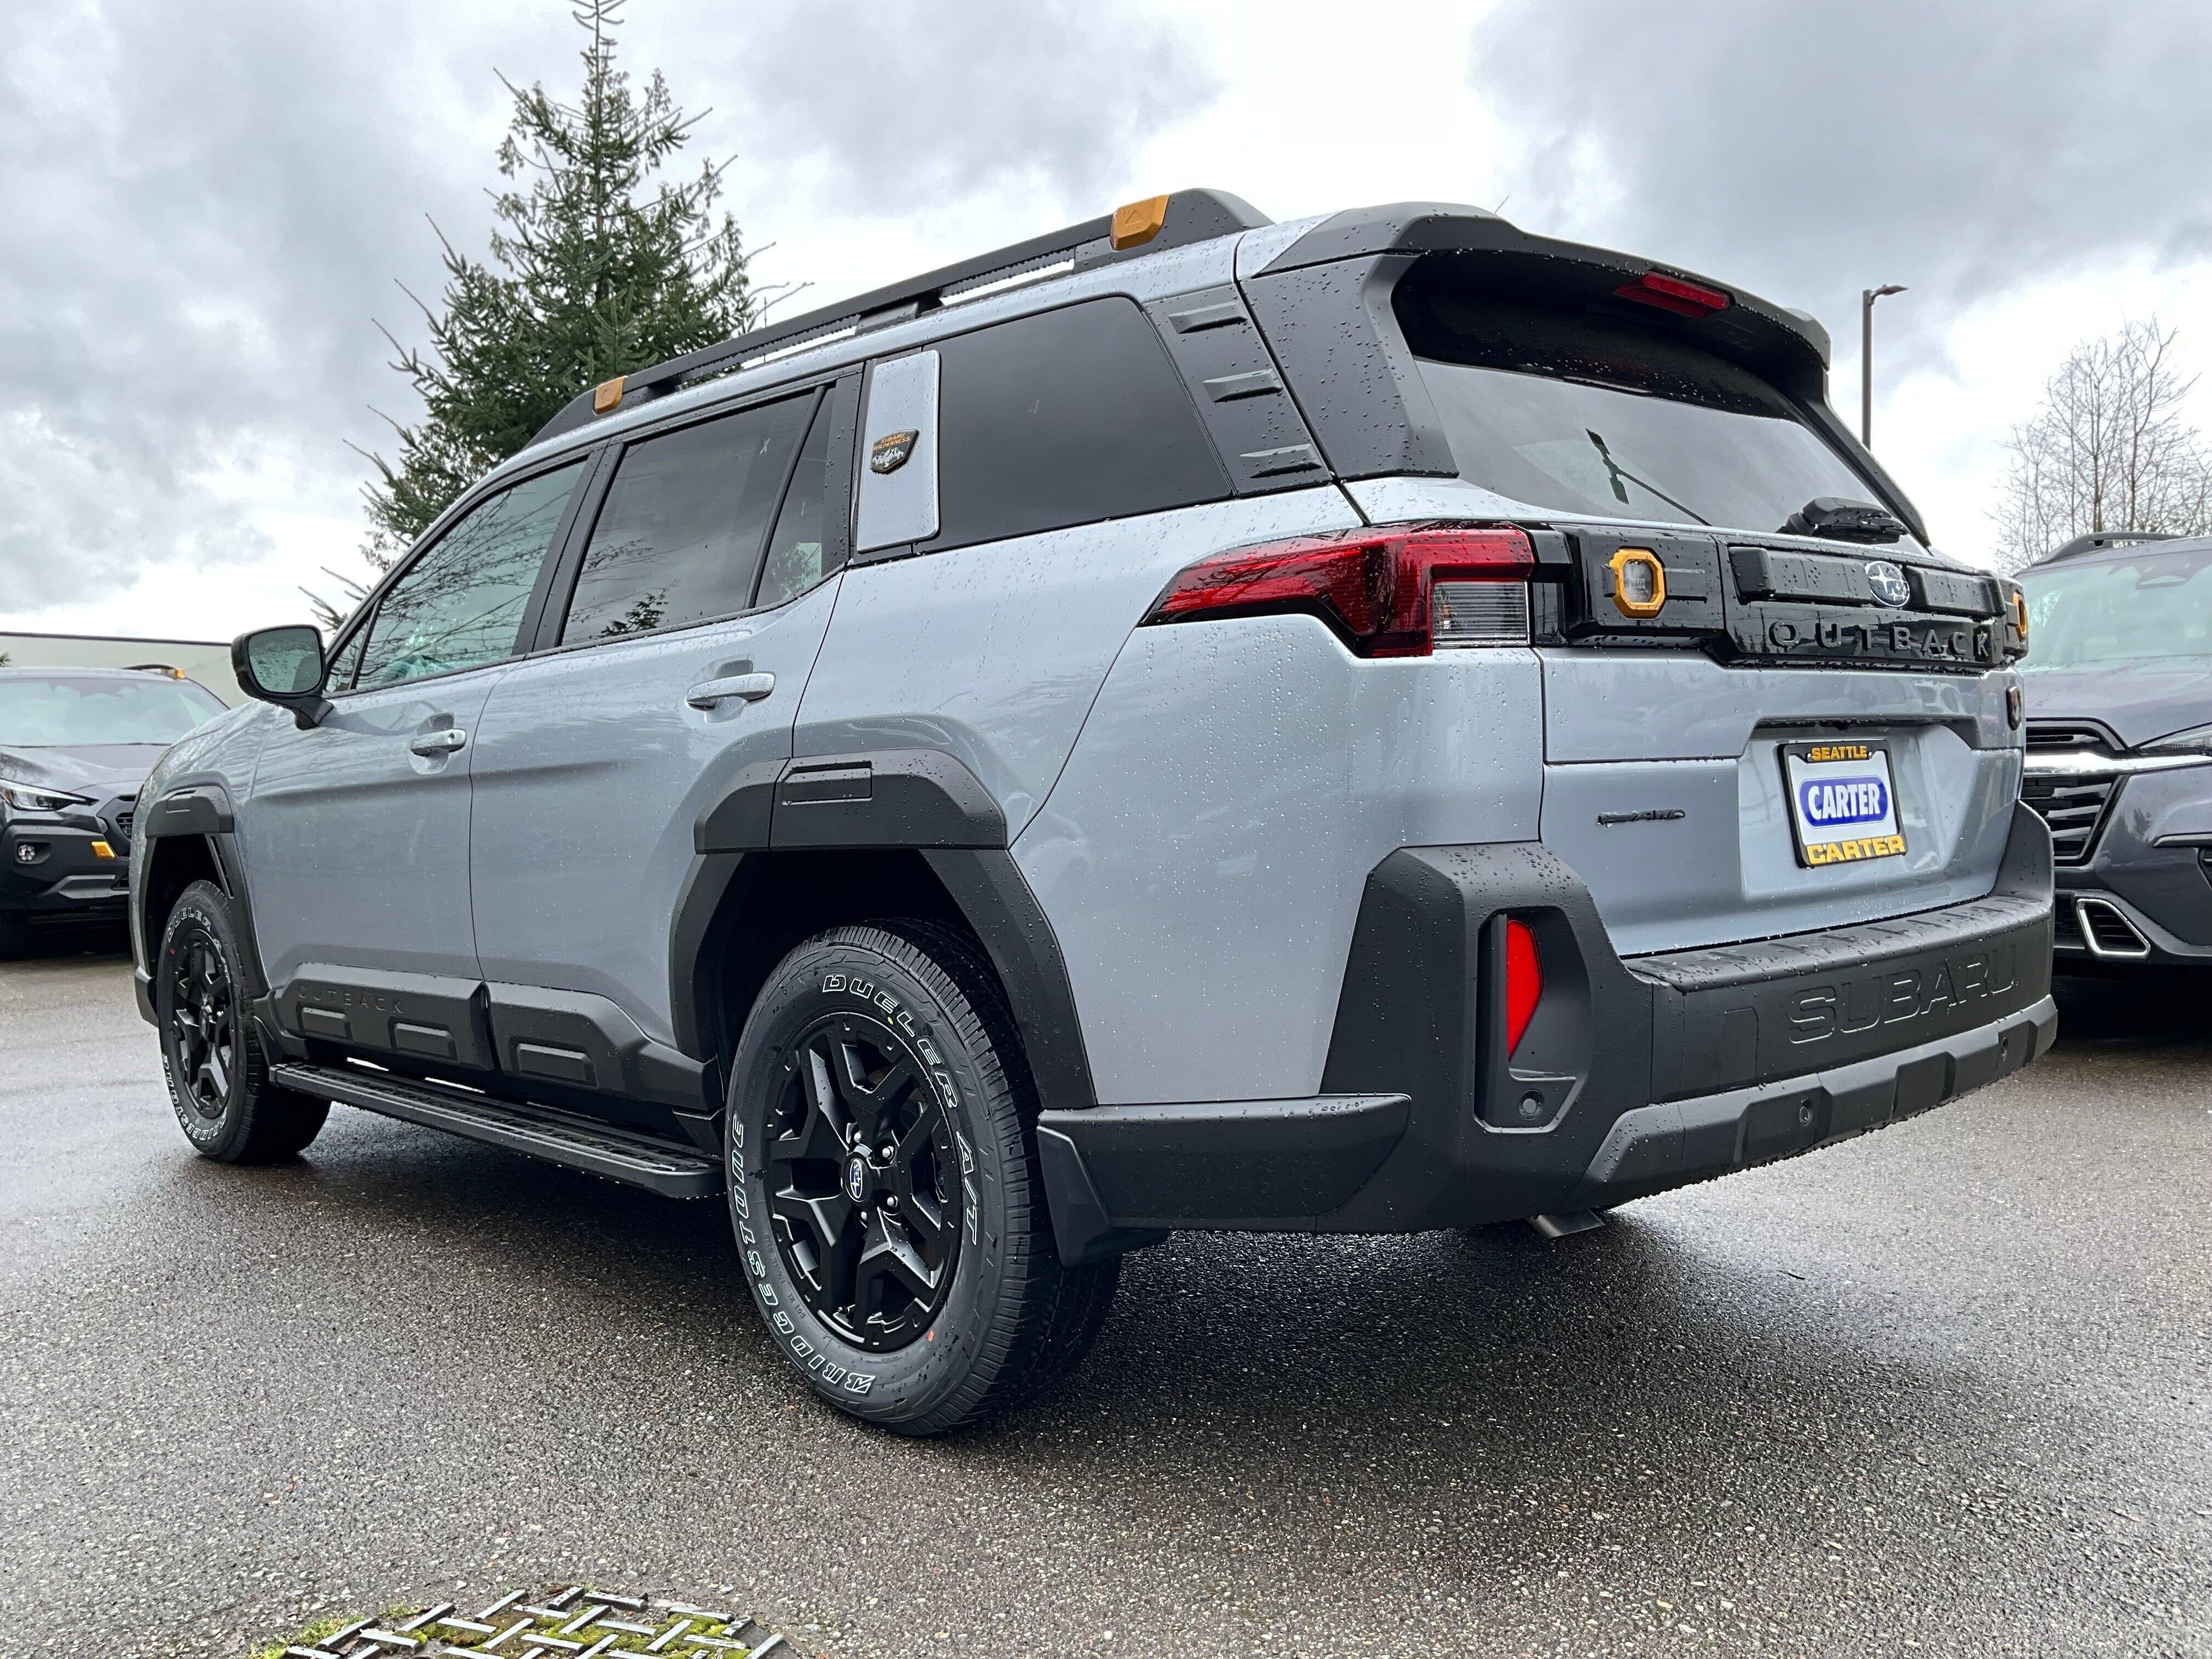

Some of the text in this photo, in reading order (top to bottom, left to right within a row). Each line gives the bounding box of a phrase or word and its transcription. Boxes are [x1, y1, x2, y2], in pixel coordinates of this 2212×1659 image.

[873, 436, 911, 451] WILDERNESS
[881, 433, 905, 443] SUBARU
[1769, 620, 1990, 657] OUTBACK
[1811, 746, 1867, 760] SEATTLE
[1808, 783, 1881, 820] CARTER
[1807, 835, 1905, 865] CARTER
[167, 907, 211, 943] DUELER
[298, 983, 403, 1014] OUTBACK
[1789, 944, 2018, 1045] SUBARU
[822, 974, 979, 1246] DUELER A/T
[733, 1114, 876, 1394] BRIDGESTONE
